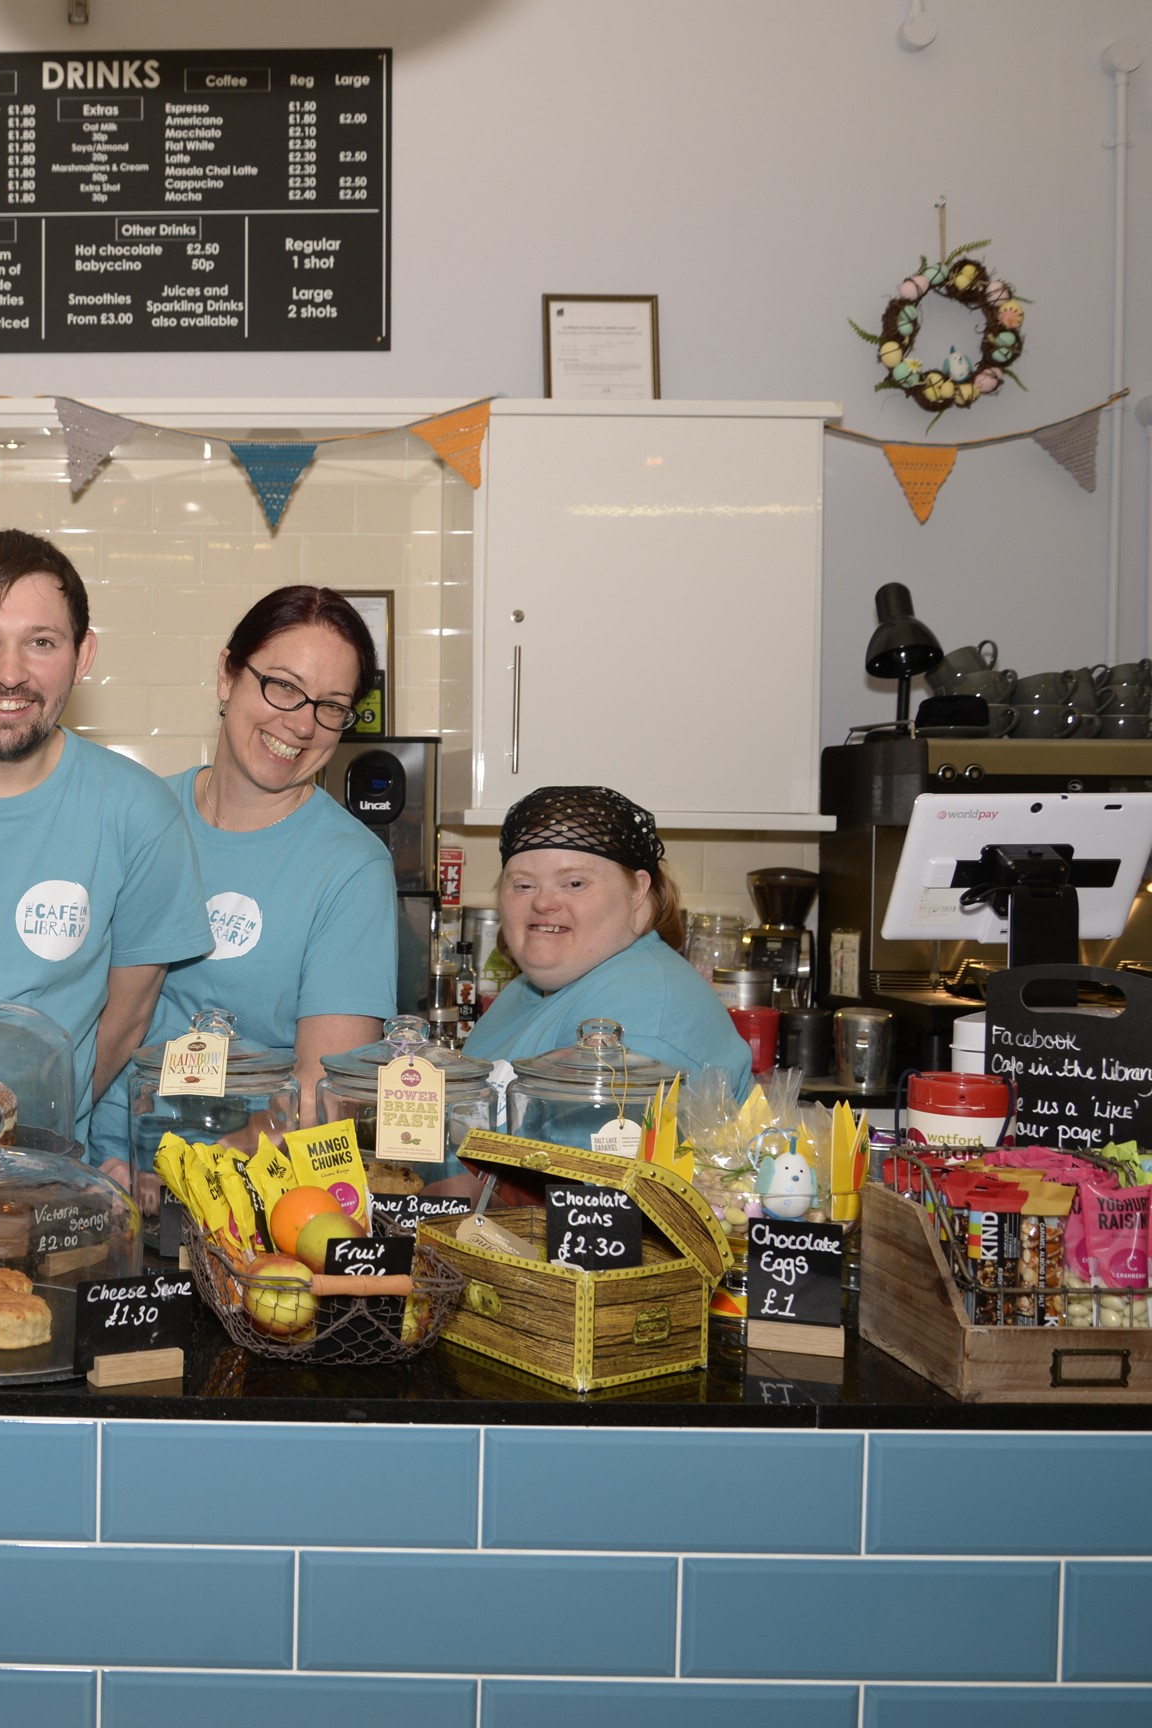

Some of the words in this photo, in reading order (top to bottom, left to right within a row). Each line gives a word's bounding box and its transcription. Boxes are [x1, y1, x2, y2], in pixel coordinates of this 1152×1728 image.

[42, 60, 160, 89] DRINKS
[206, 75, 247, 87] Coffee
[290, 75, 314, 88] Reg
[335, 74, 370, 88] Large
[83, 104, 118, 116] Extras
[165, 103, 209, 115] Espresso
[165, 115, 223, 126] Americano
[340, 113, 367, 124] £2.00
[165, 128, 221, 138] Macchiato
[165, 141, 184, 151] Flat
[186, 140, 215, 150] White
[165, 153, 190, 163] Latte
[339, 151, 367, 162] £2.50
[165, 166, 203, 176] Masala
[206, 165, 230, 176] Chai
[233, 165, 258, 175] Latte
[165, 179, 224, 190] Cappucino
[339, 176, 367, 187] £2.50
[165, 191, 202, 201] Mocha
[339, 189, 367, 199] £2.60
[122, 224, 156, 236] Other
[160, 224, 196, 235] Drinks
[75, 244, 96, 256] Hot
[99, 244, 162, 256] chocolate
[187, 243, 219, 255] £2.50
[286, 237, 341, 253] Regular
[75, 259, 141, 273] Babyccino
[192, 259, 214, 272] 50p
[304, 255, 334, 269] shot
[162, 285, 200, 296] Juices
[204, 285, 228, 296] and
[293, 287, 333, 303] Large
[69, 293, 131, 305] Smoothies
[147, 300, 203, 314] Sparkling
[207, 300, 243, 311] Drinks
[301, 304, 337, 318] shots
[67, 314, 97, 324] From
[100, 313, 133, 324] £3.00
[152, 315, 177, 327] also
[180, 315, 238, 327] available
[35, 902, 79, 921] CAFÉ
[23, 919, 85, 938] LIBRARY
[992, 1025, 1081, 1051] Facebook
[169, 1052, 221, 1067] RAINBOW
[168, 1065, 220, 1075] NATION
[991, 1054, 1024, 1081] Cafe
[1028, 1057, 1053, 1076] in
[1056, 1058, 1097, 1080] the
[384, 1089, 438, 1102] POWER
[383, 1101, 438, 1114] BREAK
[1032, 1099, 1060, 1116] us
[1065, 1102, 1078, 1116] a
[383, 1113, 438, 1128] FAST
[307, 1135, 349, 1158] MANGO
[311, 1150, 353, 1171] CHUNKS
[551, 1191, 632, 1209] Chocolate
[35, 1204, 79, 1224] Victoria
[568, 1209, 613, 1227] Coins
[751, 1223, 843, 1255] Chocolate
[981, 1211, 998, 1260] KIND
[37, 1235, 78, 1252] £2.00
[558, 1231, 625, 1260] £2.30
[335, 1240, 385, 1262] Fruit
[760, 1250, 809, 1286] Eggs
[87, 1284, 148, 1302] Cheese
[151, 1276, 192, 1300] Scone
[760, 1288, 796, 1316] £1
[105, 1302, 159, 1328] £1.30
